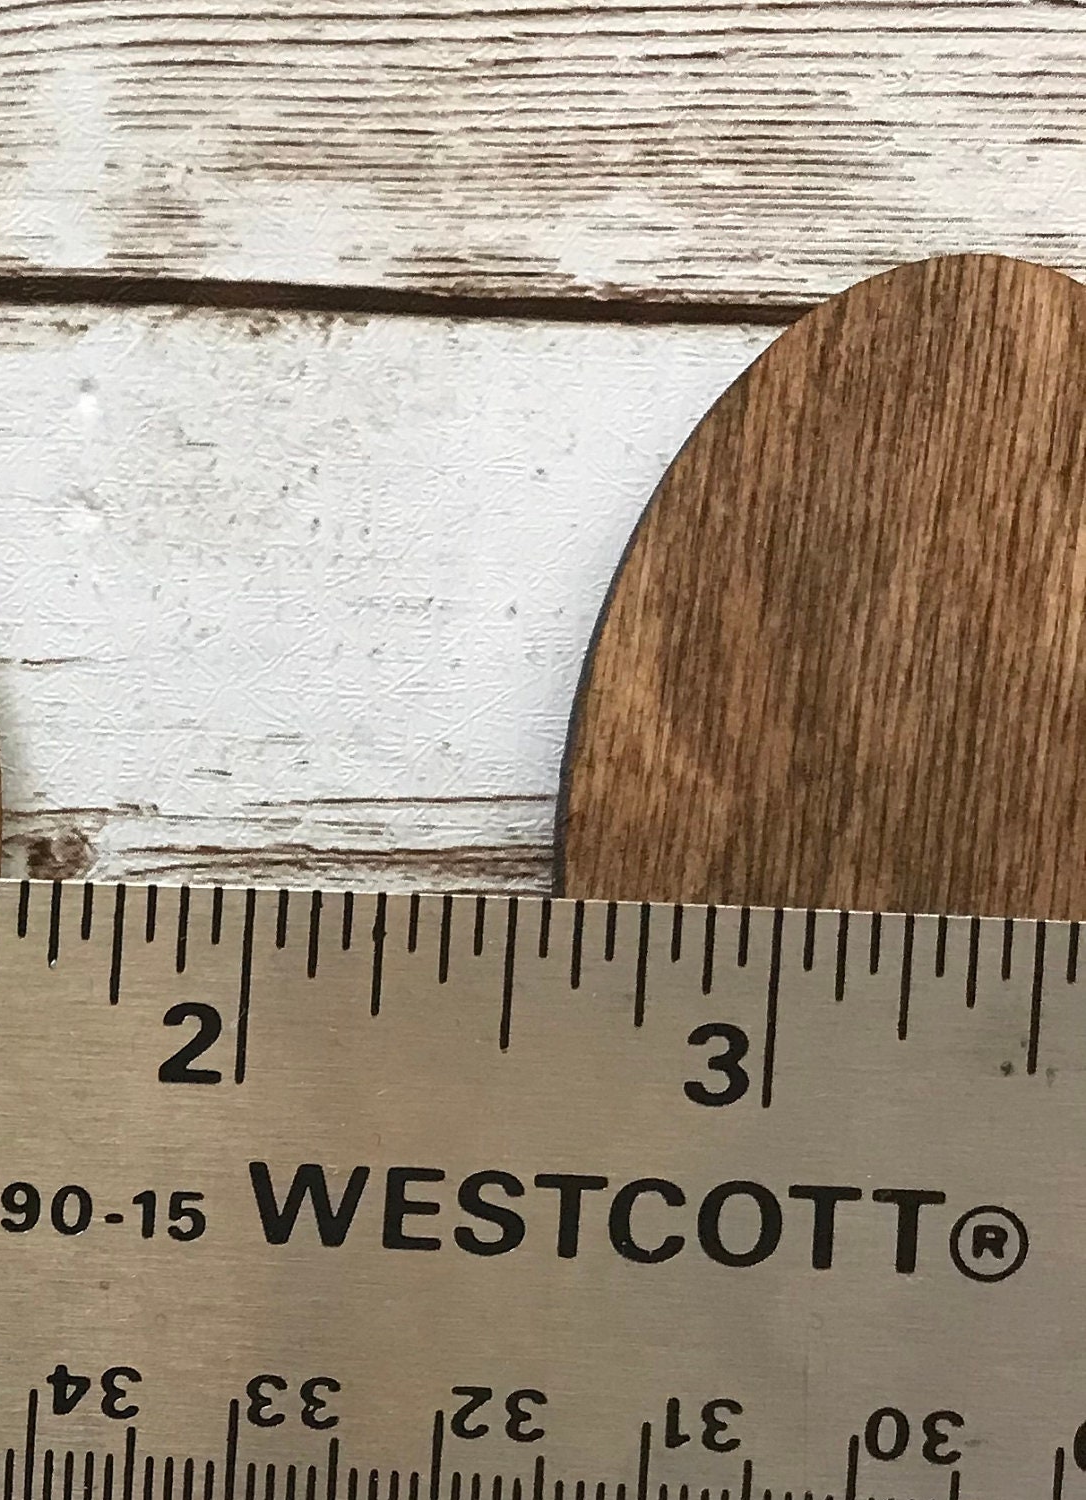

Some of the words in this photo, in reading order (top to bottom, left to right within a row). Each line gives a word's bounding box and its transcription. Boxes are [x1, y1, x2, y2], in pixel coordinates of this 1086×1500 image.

[158, 1001, 222, 1085] 2
[683, 1022, 750, 1108] 3
[45, 1364, 143, 1420] 34
[245, 1374, 342, 1431] 33
[450, 1386, 548, 1443] 32
[664, 1397, 744, 1454] 31
[864, 1406, 965, 1466] 30
